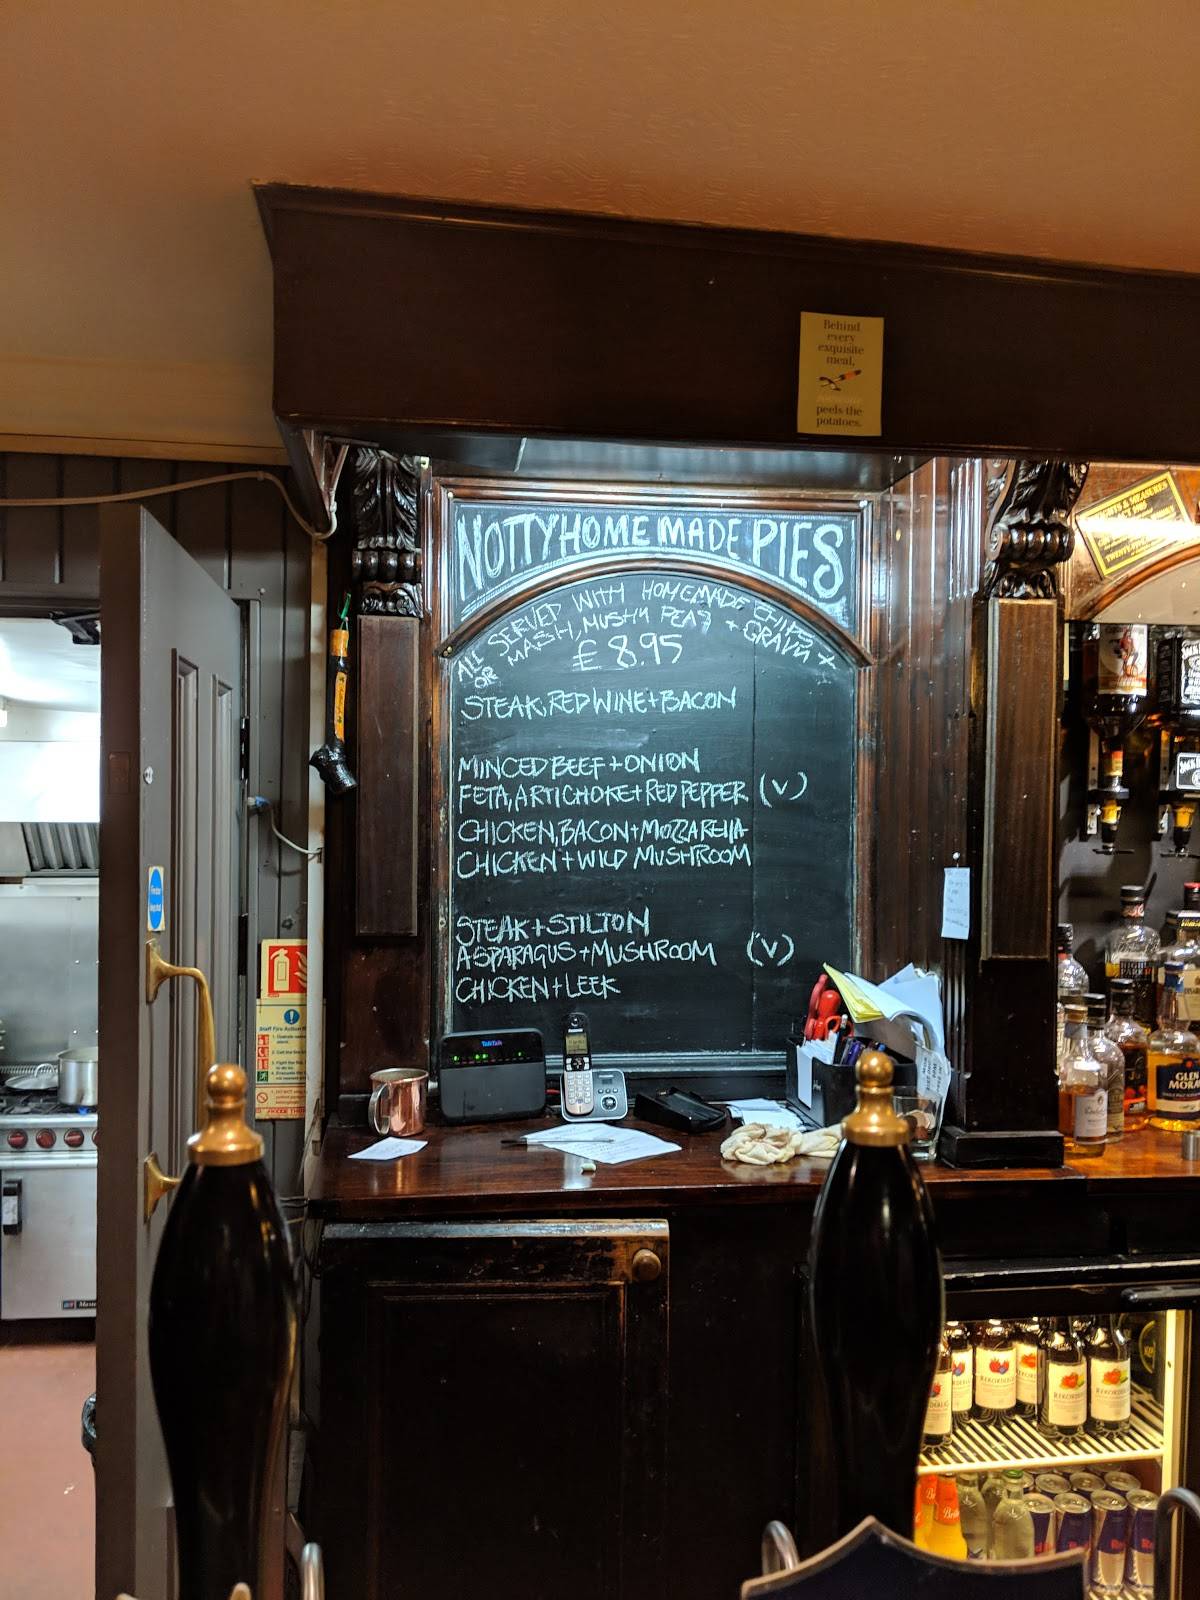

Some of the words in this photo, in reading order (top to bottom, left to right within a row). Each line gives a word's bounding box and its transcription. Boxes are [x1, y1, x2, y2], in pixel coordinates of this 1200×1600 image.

[823, 319, 861, 331] Behind
[827, 333, 855, 343] every
[817, 344, 864, 355] exquisite
[826, 356, 855, 367] meal,
[816, 404, 843, 416] peels
[846, 405, 862, 416] the
[559, 512, 651, 560] HOME
[657, 515, 742, 560] MADE
[752, 518, 845, 600] PIES
[457, 650, 485, 682] ALL
[488, 602, 562, 657] SERVED
[572, 582, 625, 613] WITH
[642, 579, 746, 610] HOMEMADE
[753, 601, 816, 650] CHIPS
[474, 666, 499, 689] OR
[582, 606, 650, 634] MUSHY
[660, 605, 713, 630] PEAS
[743, 620, 811, 664] GRAVY
[548, 689, 591, 717] RED
[457, 754, 550, 783] MINCED
[551, 754, 605, 781] BEEF
[645, 777, 679, 806] RED
[680, 780, 750, 809] PEPPER
[456, 848, 558, 880] CHICKEN
[633, 842, 752, 870] MUSHROOM
[455, 914, 531, 947] STEAK
[456, 941, 577, 973] ASPARAGUS
[455, 975, 550, 1004] CHICKEN
[565, 971, 622, 1000] LEEK
